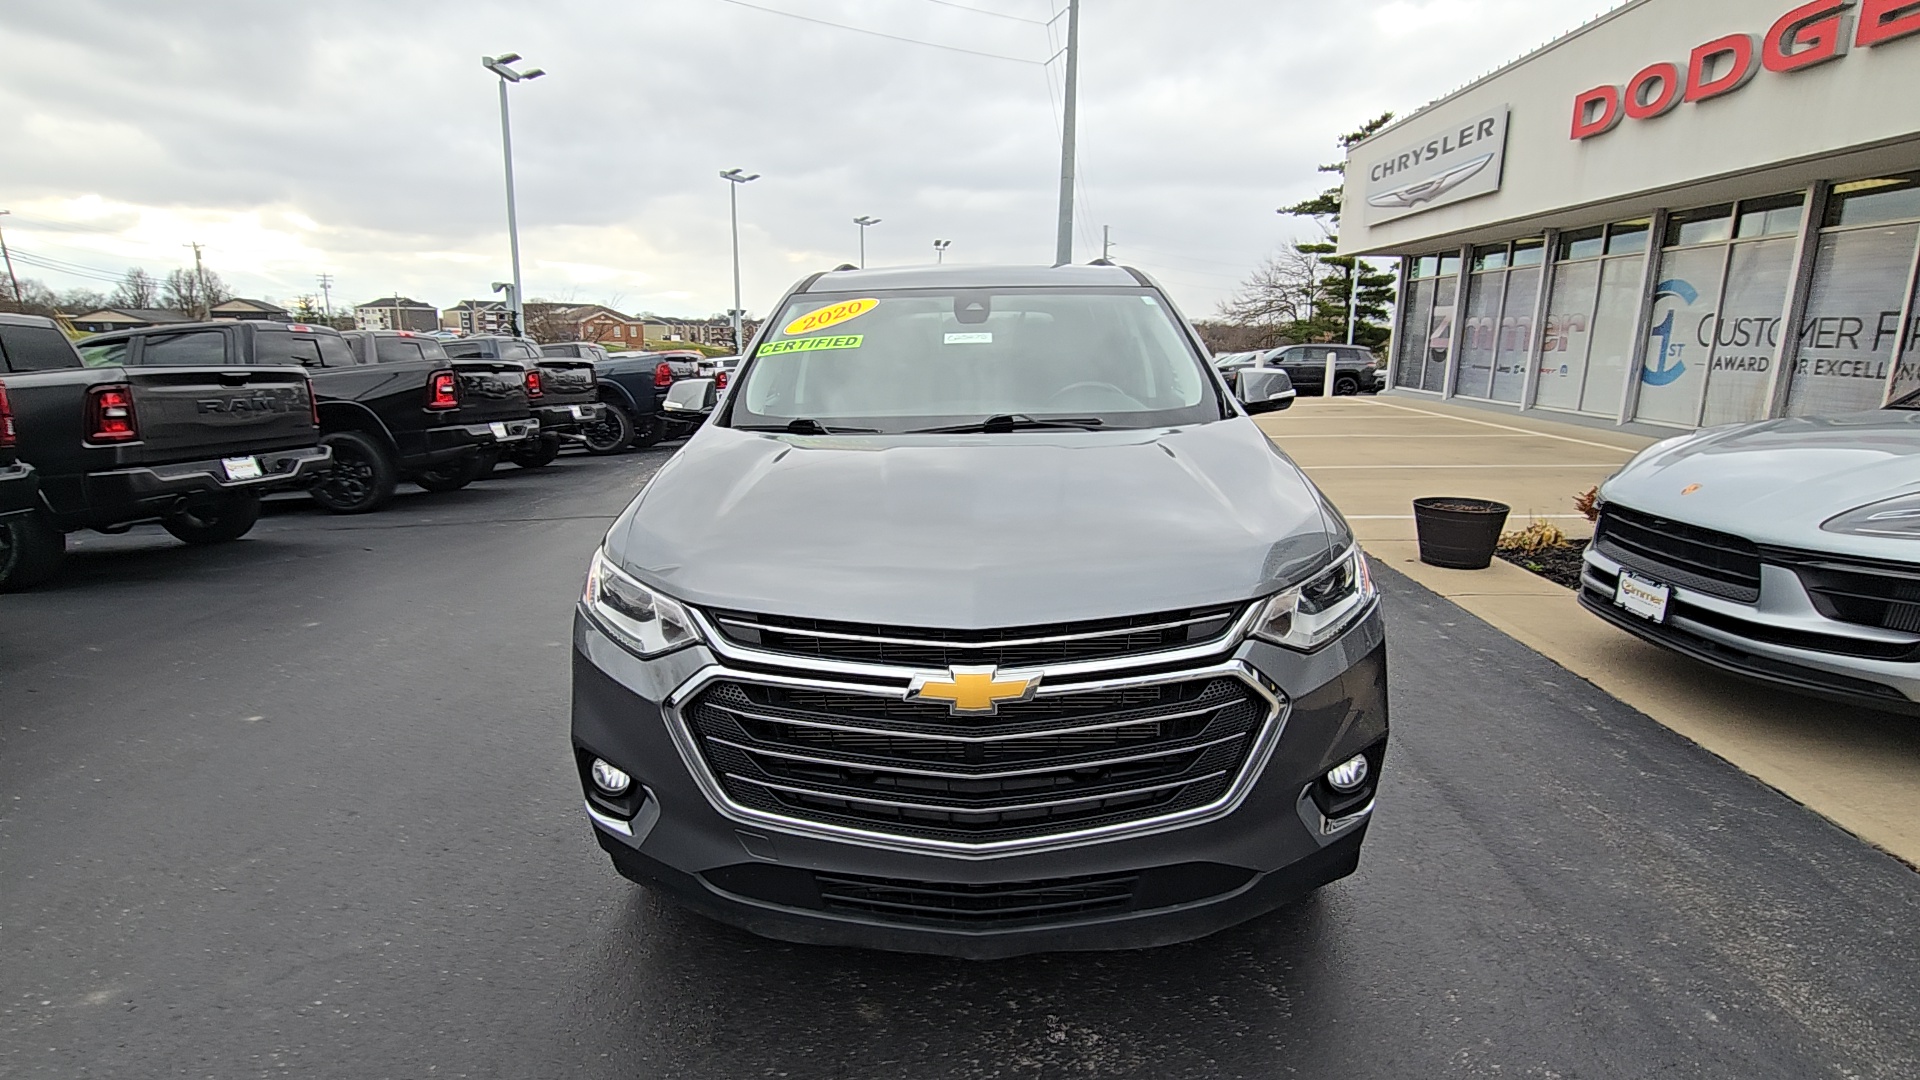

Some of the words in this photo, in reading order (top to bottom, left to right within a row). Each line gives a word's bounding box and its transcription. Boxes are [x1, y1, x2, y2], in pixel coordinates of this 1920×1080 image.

[1370, 117, 1495, 182] CHRYSLER
[803, 302, 862, 331] 2020
[1430, 305, 1585, 352] Zmmer
[760, 336, 857, 355] CERTIFIED
[1712, 355, 1770, 372] AWARD
